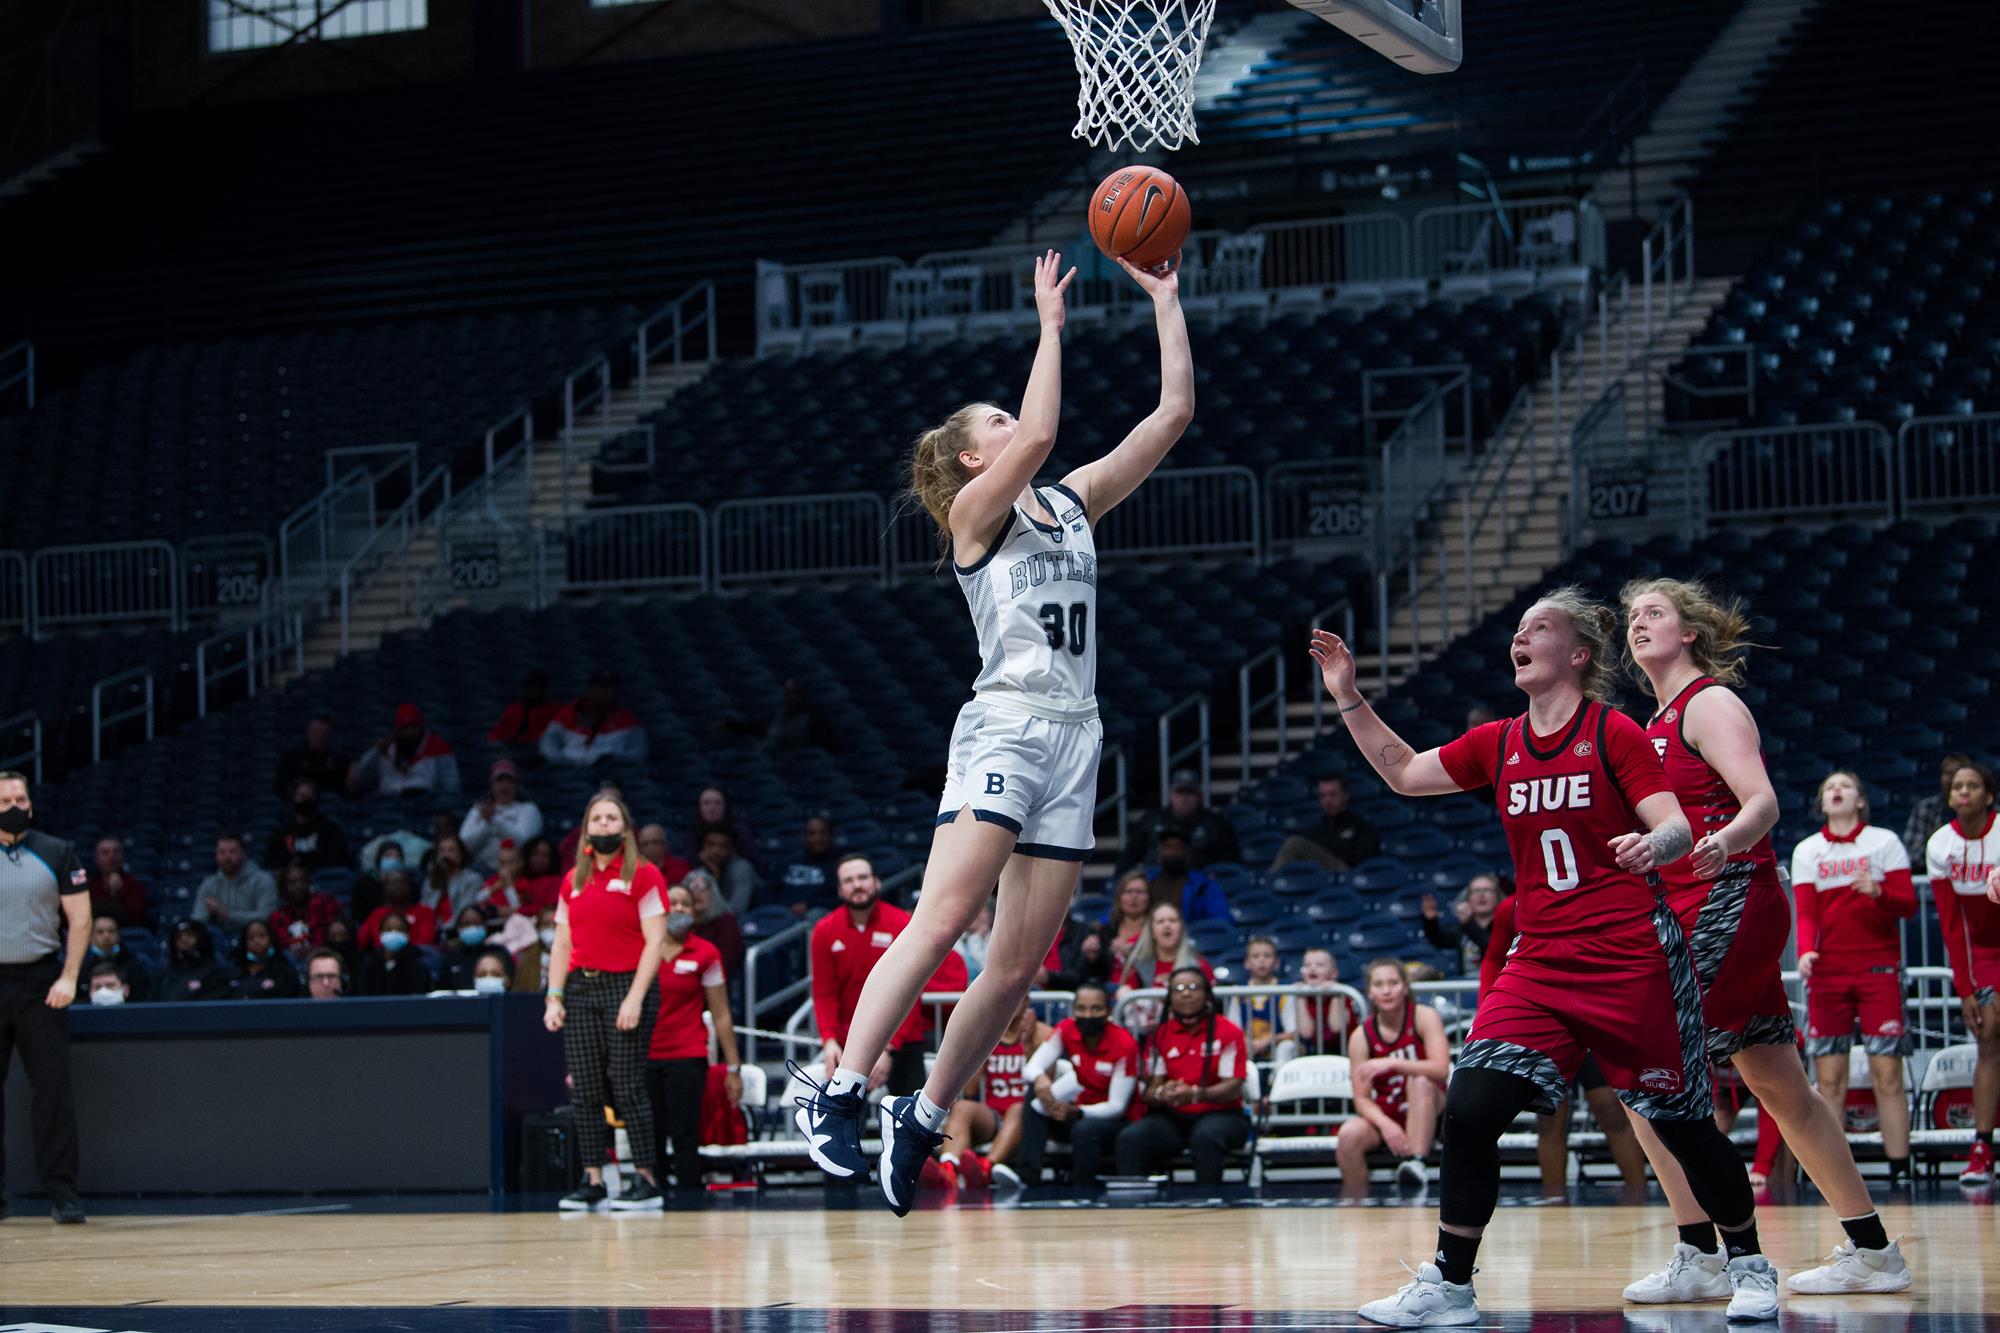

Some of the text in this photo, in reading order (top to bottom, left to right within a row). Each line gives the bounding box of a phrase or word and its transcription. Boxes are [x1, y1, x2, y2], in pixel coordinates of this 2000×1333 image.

[1101, 172, 1136, 215] ELITE
[1309, 504, 1361, 536] 206
[1592, 484, 1644, 517] 207
[1038, 601, 1088, 657] 30
[984, 772, 1006, 795] B
[1506, 772, 1593, 818] SIUE
[1540, 827, 1580, 893] 0
